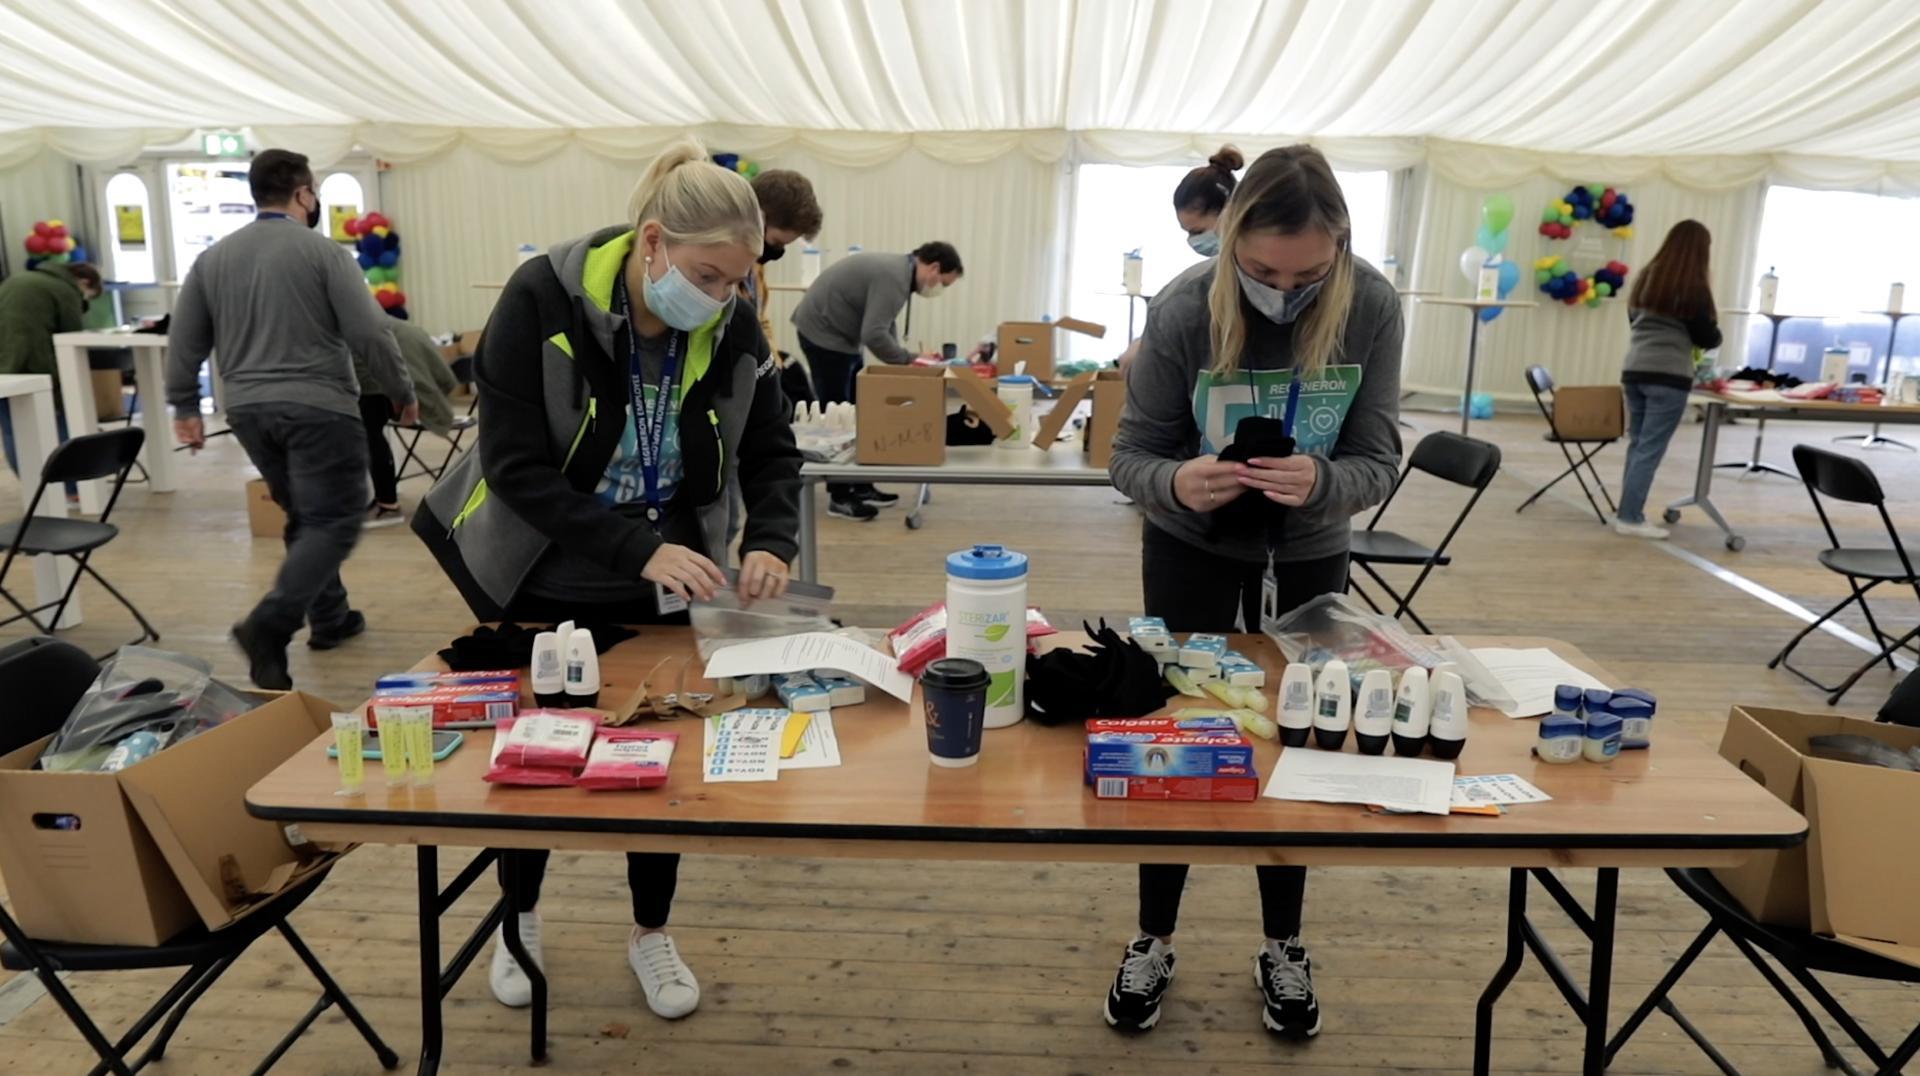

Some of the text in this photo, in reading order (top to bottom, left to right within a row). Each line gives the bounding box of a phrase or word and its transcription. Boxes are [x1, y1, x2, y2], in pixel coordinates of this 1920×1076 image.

[631, 374, 646, 416] EMPLOYEE
[655, 375, 672, 423] REGENERON
[637, 417, 652, 467] REGENERON
[1096, 719, 1169, 727] Colgate
[1161, 736, 1241, 745] Colgate
